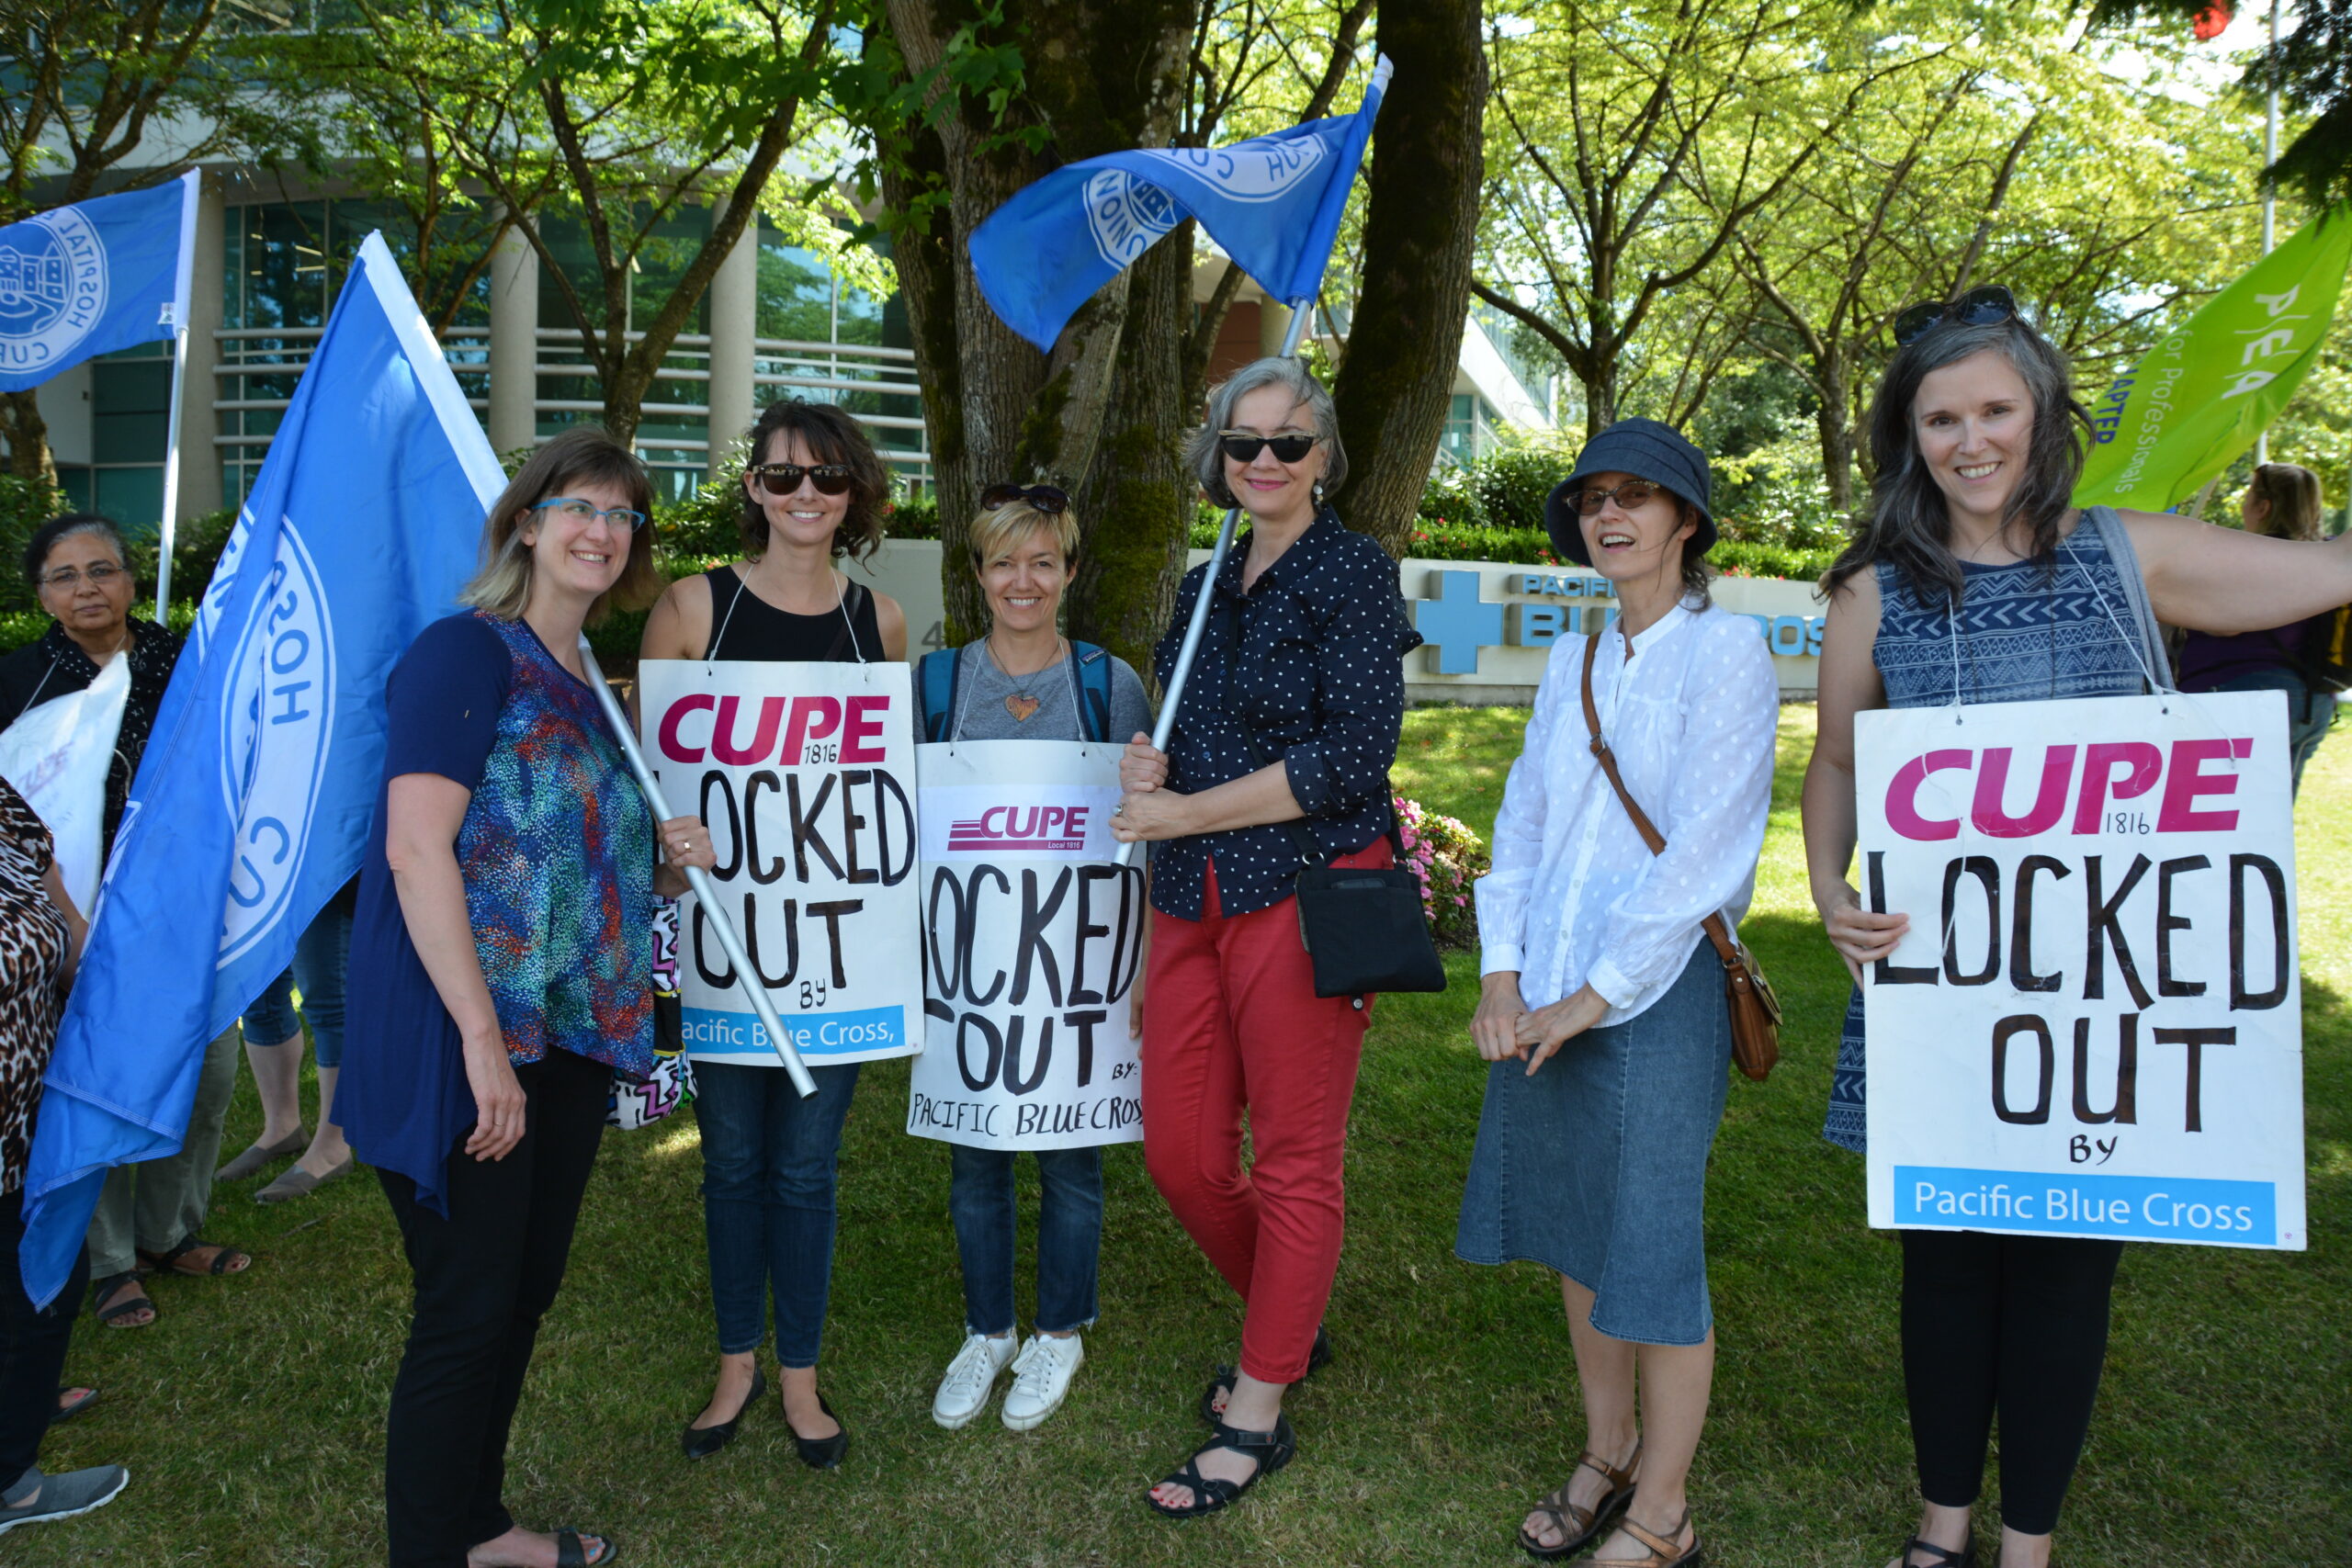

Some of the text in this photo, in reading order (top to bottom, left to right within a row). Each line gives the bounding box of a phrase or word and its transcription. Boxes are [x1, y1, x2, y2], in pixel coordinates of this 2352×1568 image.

[1522, 574, 1617, 597] PACIFI
[658, 693, 891, 767] CUPE
[804, 743, 838, 764] 1816
[1883, 737, 2255, 842] CUPE
[652, 768, 917, 887] OCKED
[979, 806, 1090, 840] CUPE
[1047, 840, 1080, 850] Local 1816
[2106, 811, 2151, 835] 1816
[692, 892, 865, 989] OUT
[1866, 850, 2290, 1012] LOCKED
[682, 1018, 744, 1045] acific
[956, 1010, 1107, 1097] OUT
[1991, 1011, 2237, 1134] OUT
[910, 1092, 1144, 1137] PACIFIC BLUE CROS
[1914, 1180, 2254, 1233] Pacific Blue Cross
